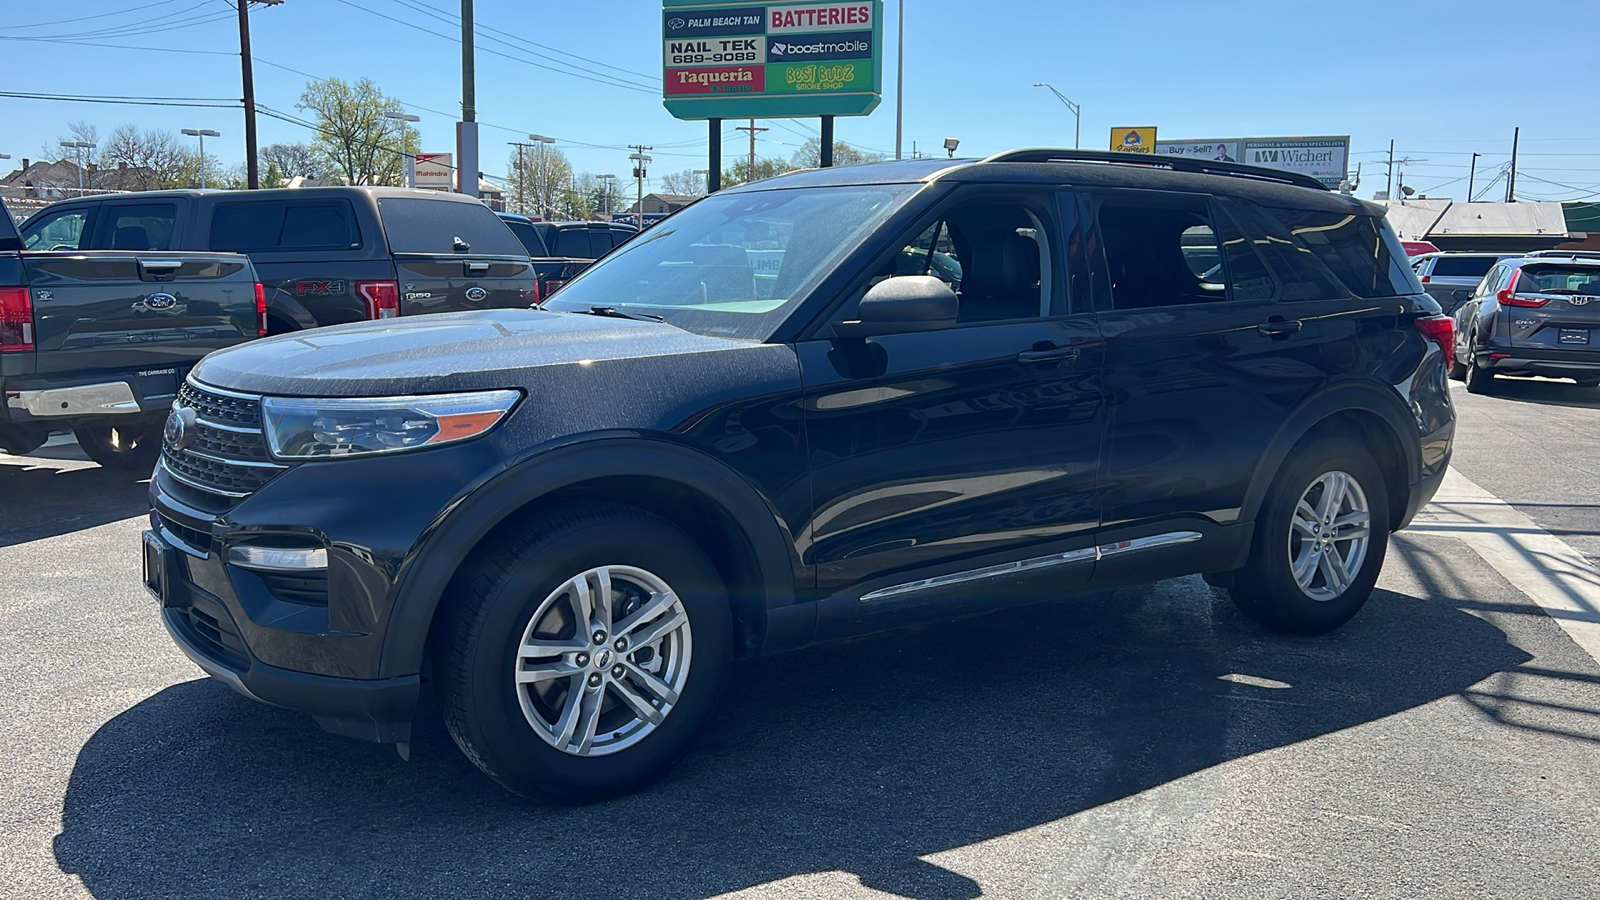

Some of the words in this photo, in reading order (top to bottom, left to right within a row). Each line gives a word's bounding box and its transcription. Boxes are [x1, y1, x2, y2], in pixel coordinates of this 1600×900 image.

[687, 18, 711, 28] PALM
[712, 16, 741, 26] BEACH
[743, 15, 760, 25] TAN
[772, 6, 869, 28] BATTERIES
[670, 42, 711, 54] NAIL
[719, 39, 757, 51] TEK
[673, 52, 756, 64] 689-9088
[796, 83, 821, 91] SMOKE
[823, 82, 843, 90] SHOP
[1169, 146, 1185, 155] Buy
[1193, 145, 1212, 153] Sell?
[1281, 149, 1333, 162] Wichert
[297, 280, 344, 296] FX4
[152, 297, 169, 307] Ford
